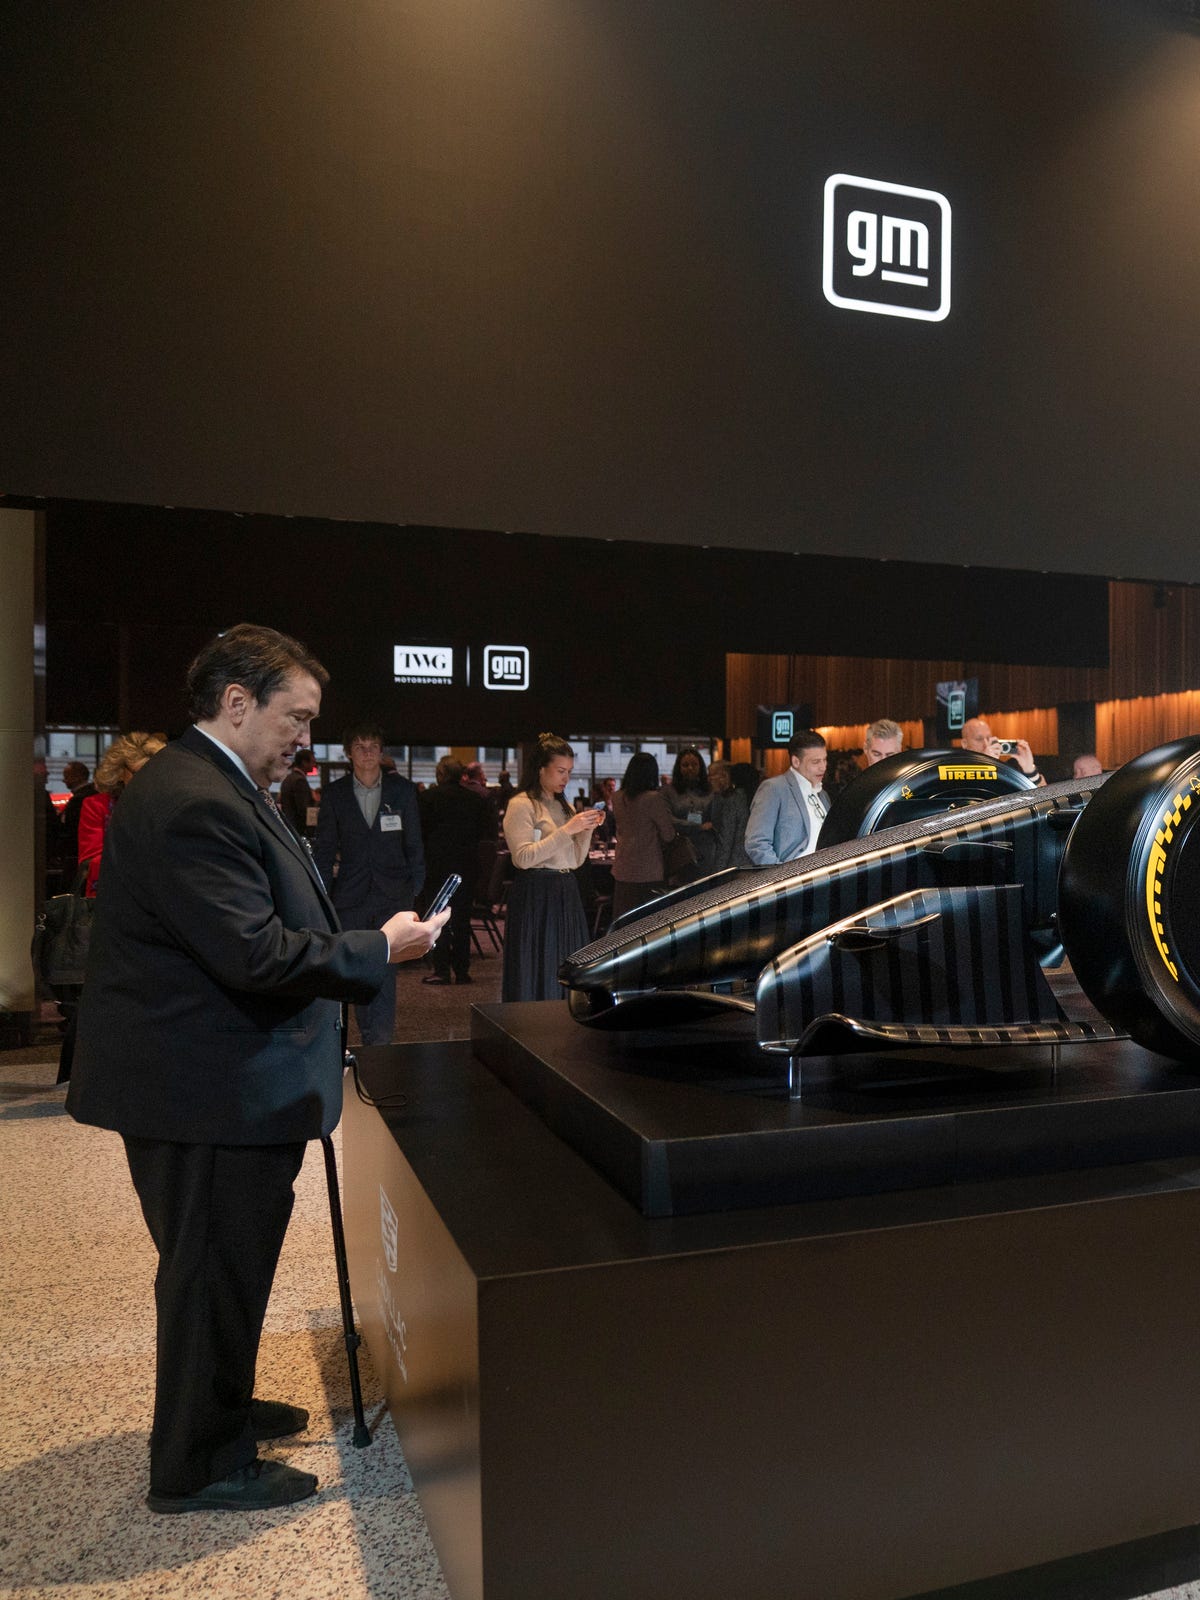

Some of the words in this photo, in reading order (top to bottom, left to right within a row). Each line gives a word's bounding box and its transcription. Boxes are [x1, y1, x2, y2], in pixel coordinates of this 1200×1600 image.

[847, 210, 929, 283] gm
[400, 653, 447, 669] TWG
[492, 656, 522, 680] gm
[394, 676, 453, 685] MOTORSPORTS
[776, 718, 790, 735] gm
[938, 764, 998, 781] PIRELLI
